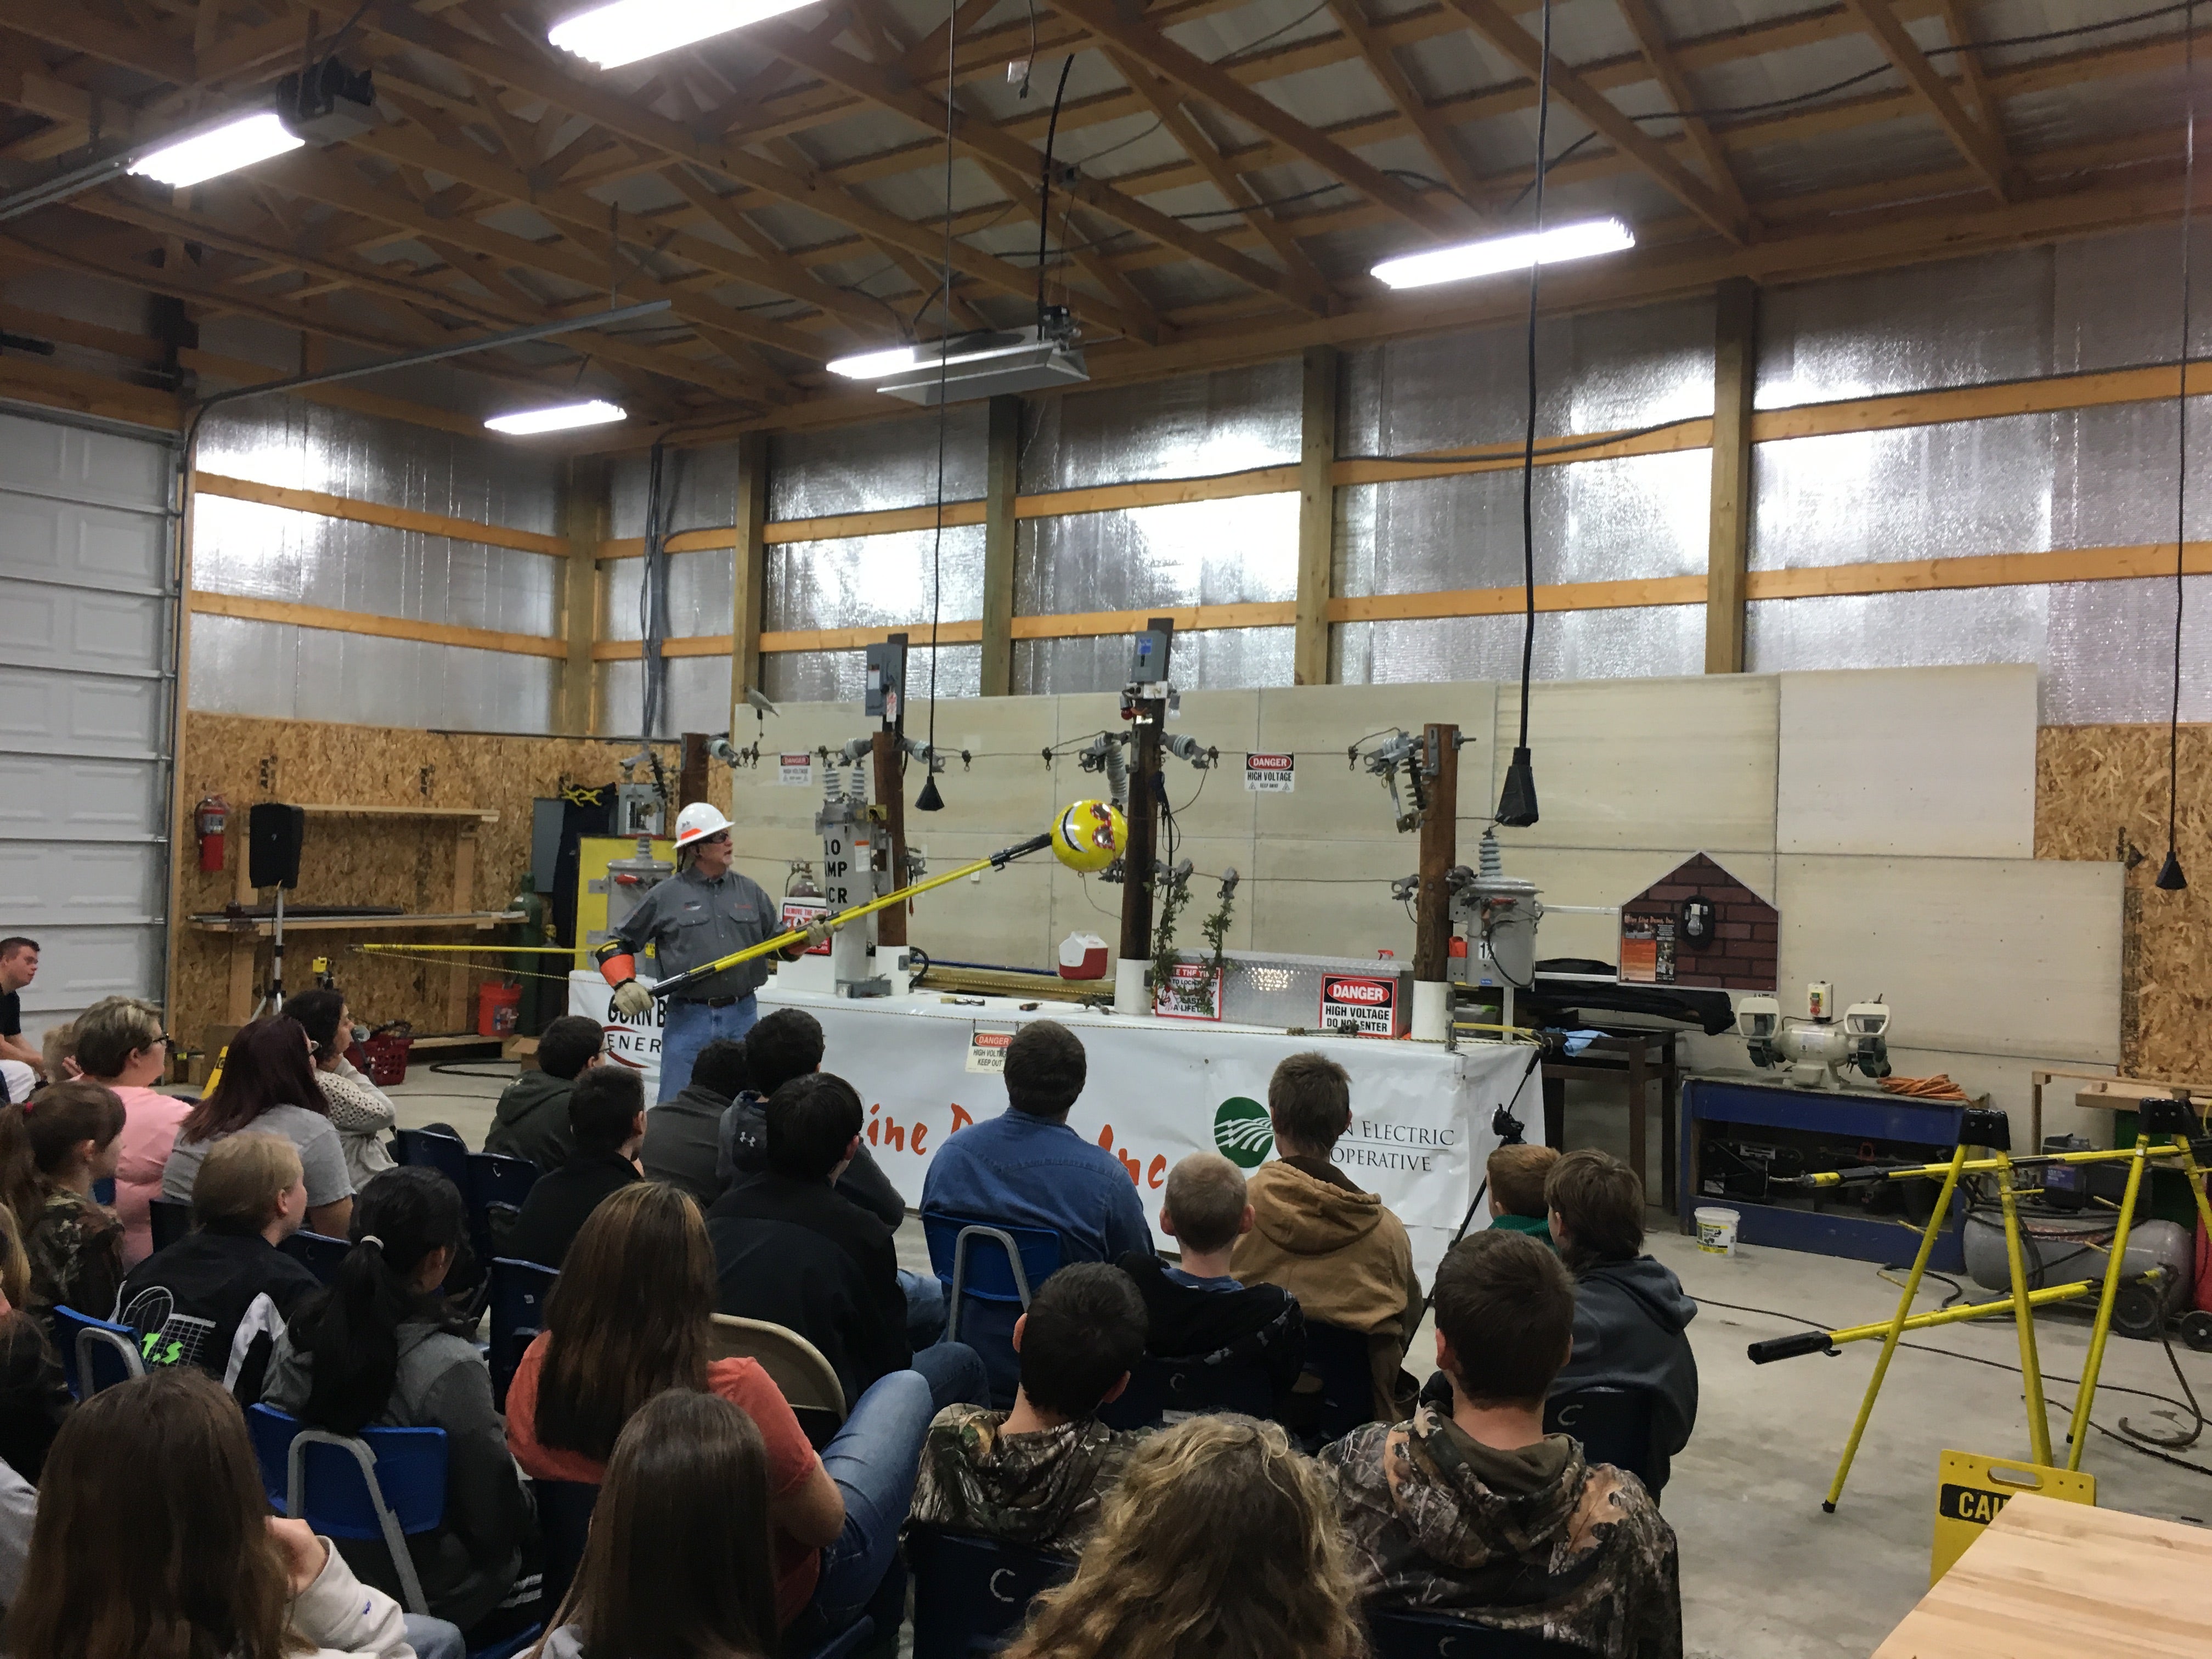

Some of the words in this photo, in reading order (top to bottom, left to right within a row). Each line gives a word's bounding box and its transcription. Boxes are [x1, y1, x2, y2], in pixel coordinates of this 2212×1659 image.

[1253, 758, 1287, 767] DANGER
[1247, 771, 1262, 781] HIGH
[1263, 771, 1291, 782] VOLTAGE
[826, 887, 848, 904] CR
[1333, 984, 1384, 1001] DANGER
[1325, 1005, 1347, 1017] HIGH
[1350, 1007, 1390, 1020] VOLTAGE
[1327, 1018, 1338, 1028] DO
[1360, 1020, 1387, 1032] ENTER
[607, 1034, 662, 1053] ENER
[979, 1036, 1009, 1045] DANGER
[973, 1048, 986, 1057] HIGH
[986, 1049, 1007, 1058] VOLTAG
[867, 1103, 928, 1155] ine
[1362, 1120, 1454, 1146] ELECTRIC
[1330, 1147, 1432, 1172] OPERATIVE
[989, 1568, 1015, 1602] C
